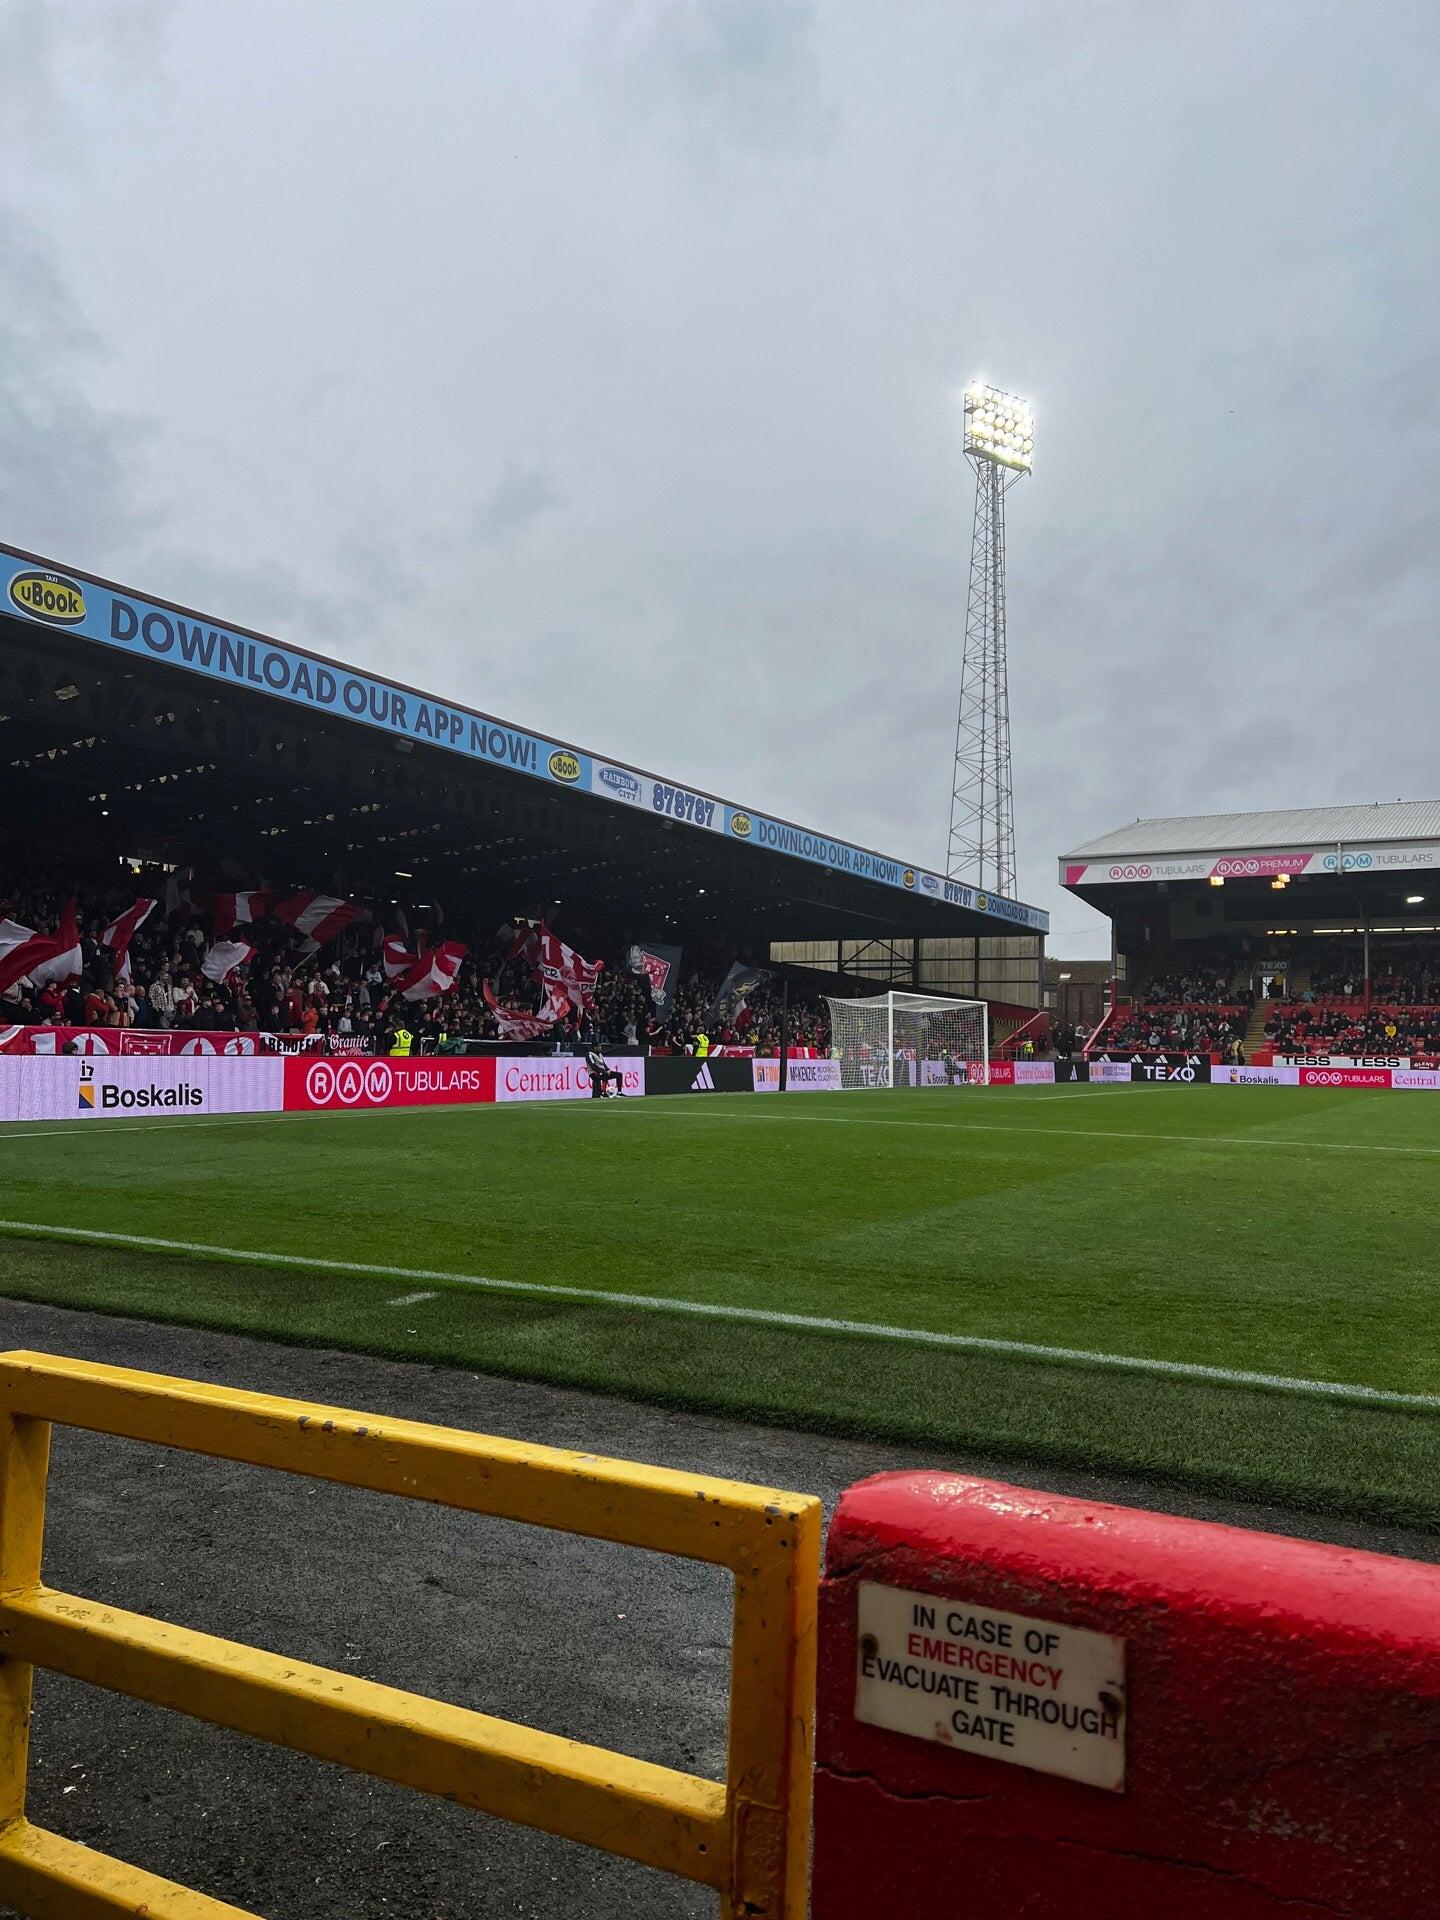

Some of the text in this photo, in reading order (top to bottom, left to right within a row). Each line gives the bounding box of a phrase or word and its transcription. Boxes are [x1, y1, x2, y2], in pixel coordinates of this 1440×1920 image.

[21, 581, 78, 614] uBook
[110, 599, 537, 770] DOWNLOAD OUR APP NOW!
[552, 759, 578, 775] uBook
[603, 770, 636, 790] RAINBOW
[618, 789, 637, 801] CITY
[652, 783, 715, 828] 878787
[759, 820, 827, 861] DOWNLOAD
[828, 845, 851, 869] OUR
[853, 855, 871, 874] APP
[872, 859, 898, 883] NOW!
[1323, 853, 1433, 870] RAM TUBULARS
[1109, 864, 1205, 880] RAM TUBULARS
[1216, 858, 1304, 875] RAM PREMIUM
[944, 881, 973, 907] 878787
[1262, 961, 1288, 969] TEXO
[1281, 1055, 1401, 1067] TESS TESS
[306, 1061, 480, 1105] RAM TUBULARS
[505, 1065, 570, 1093] Central
[1143, 1065, 1196, 1082] TEXO
[1239, 1075, 1280, 1085] Boskalis
[1305, 1071, 1385, 1085] RAM TUBULARS
[1394, 1074, 1437, 1086] Central
[102, 1083, 203, 1108] Boskalis
[913, 1604, 1060, 1656] IN CASE OF
[907, 1633, 1063, 1691] EMERGENCY
[862, 1653, 1118, 1740] EVACUATE THROUGH
[952, 1710, 1015, 1748] GATE
